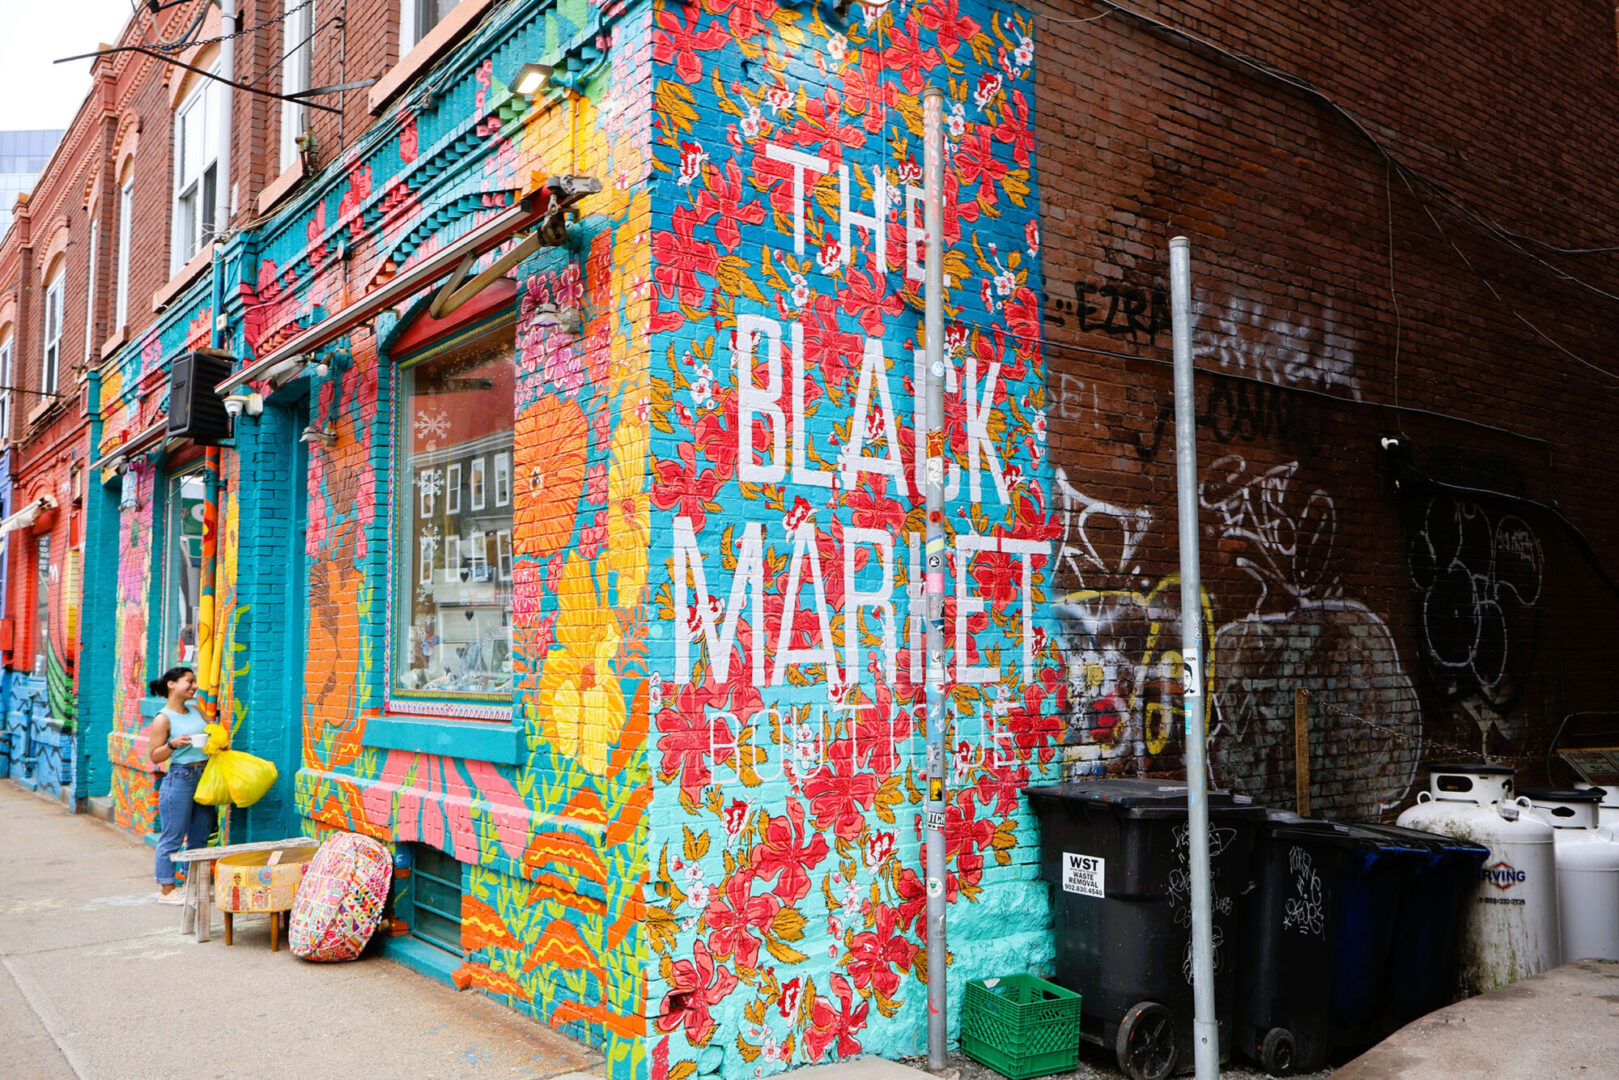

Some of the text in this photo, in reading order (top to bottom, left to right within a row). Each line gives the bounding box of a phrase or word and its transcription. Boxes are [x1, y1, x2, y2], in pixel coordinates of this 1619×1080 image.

[765, 143, 951, 287] THE
[737, 313, 1011, 505] BLACK
[1069, 855, 1099, 871] WST
[1068, 876, 1099, 889] REMOVAL
[1073, 871, 1095, 881] WASTE
[1482, 869, 1526, 883] RVING
